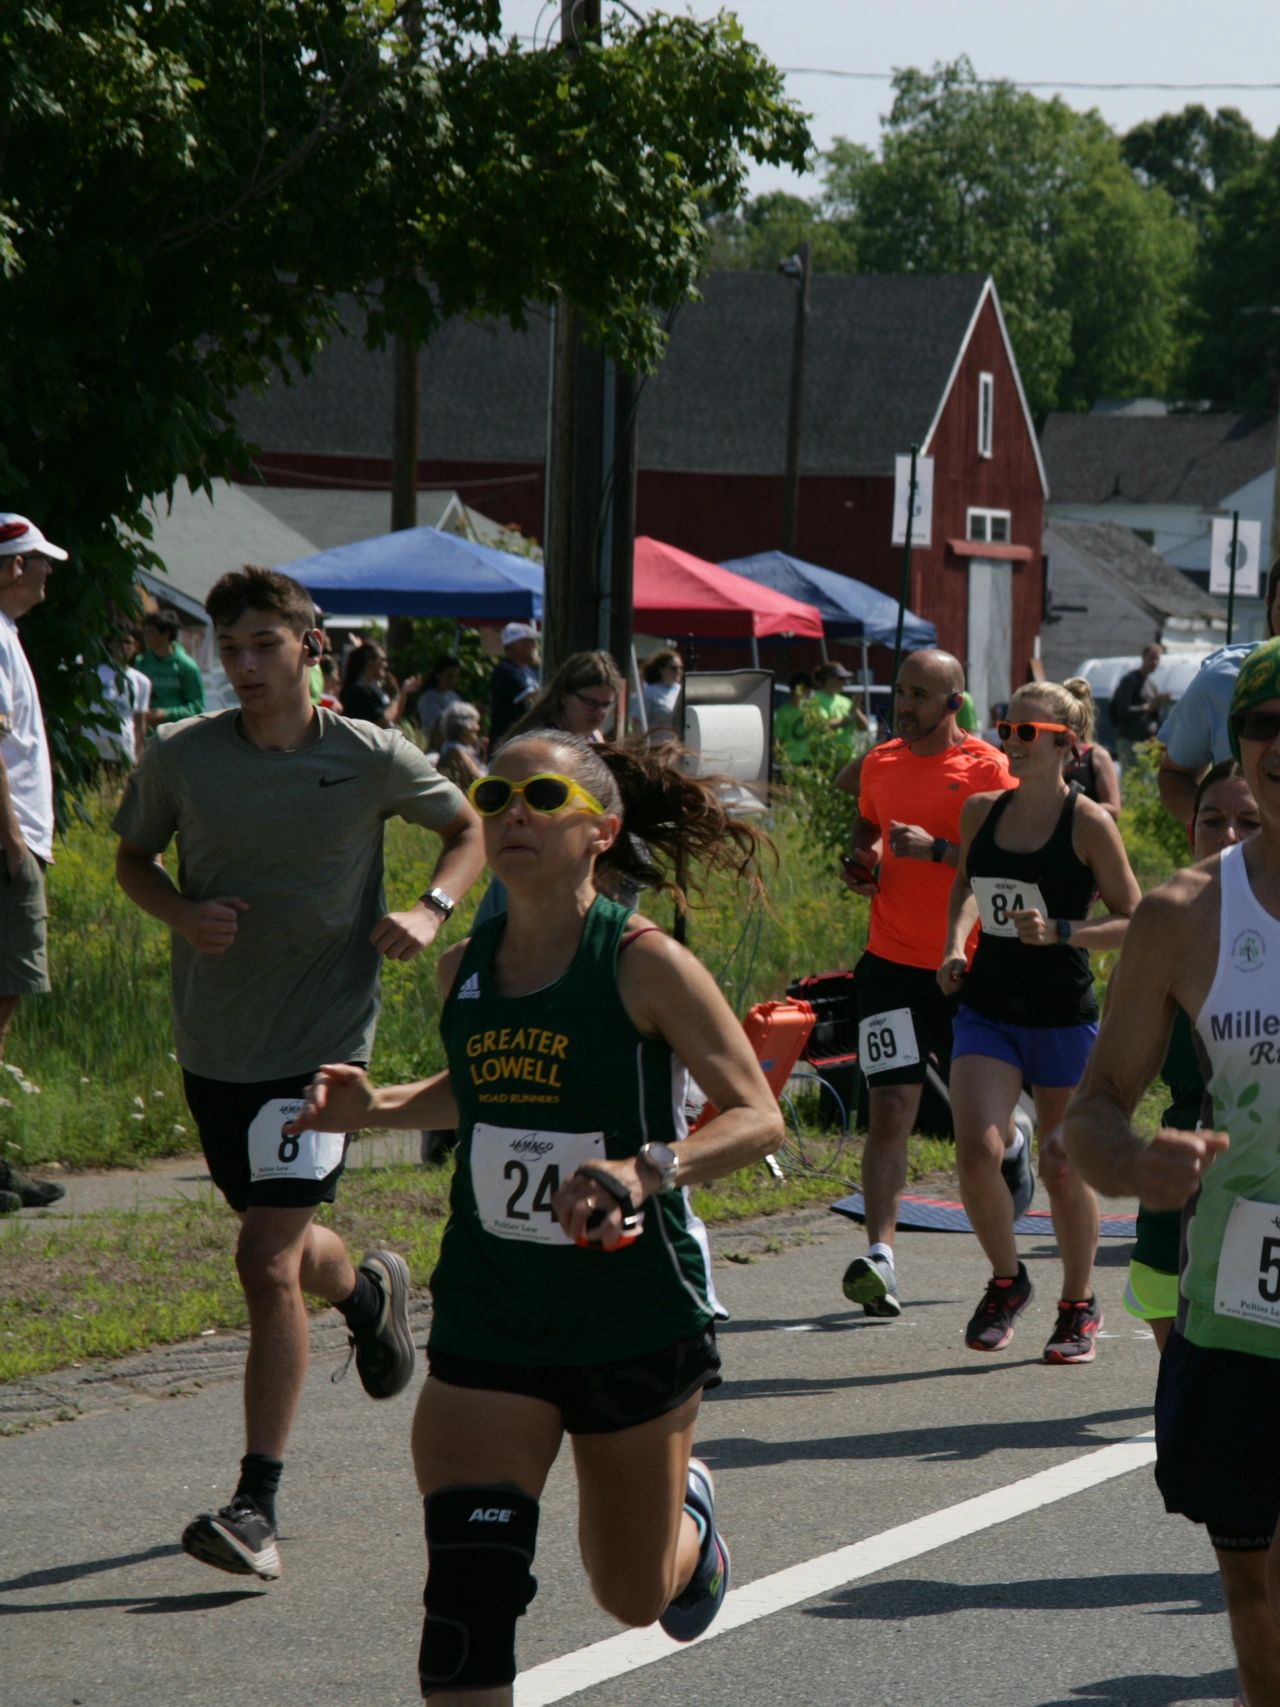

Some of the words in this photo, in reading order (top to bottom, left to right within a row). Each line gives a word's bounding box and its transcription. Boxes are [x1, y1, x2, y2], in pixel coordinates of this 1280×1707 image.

[465, 1026, 571, 1060] GREATER
[867, 1028, 897, 1062] 69
[469, 1055, 563, 1088] LOWELL
[478, 1093, 508, 1104] ROAD
[510, 1093, 561, 1104] RUNNERS
[278, 1120, 300, 1163] 8
[503, 1160, 560, 1223] 24
[1240, 1300, 1269, 1314] Peltier
[468, 1508, 513, 1523] ACE
